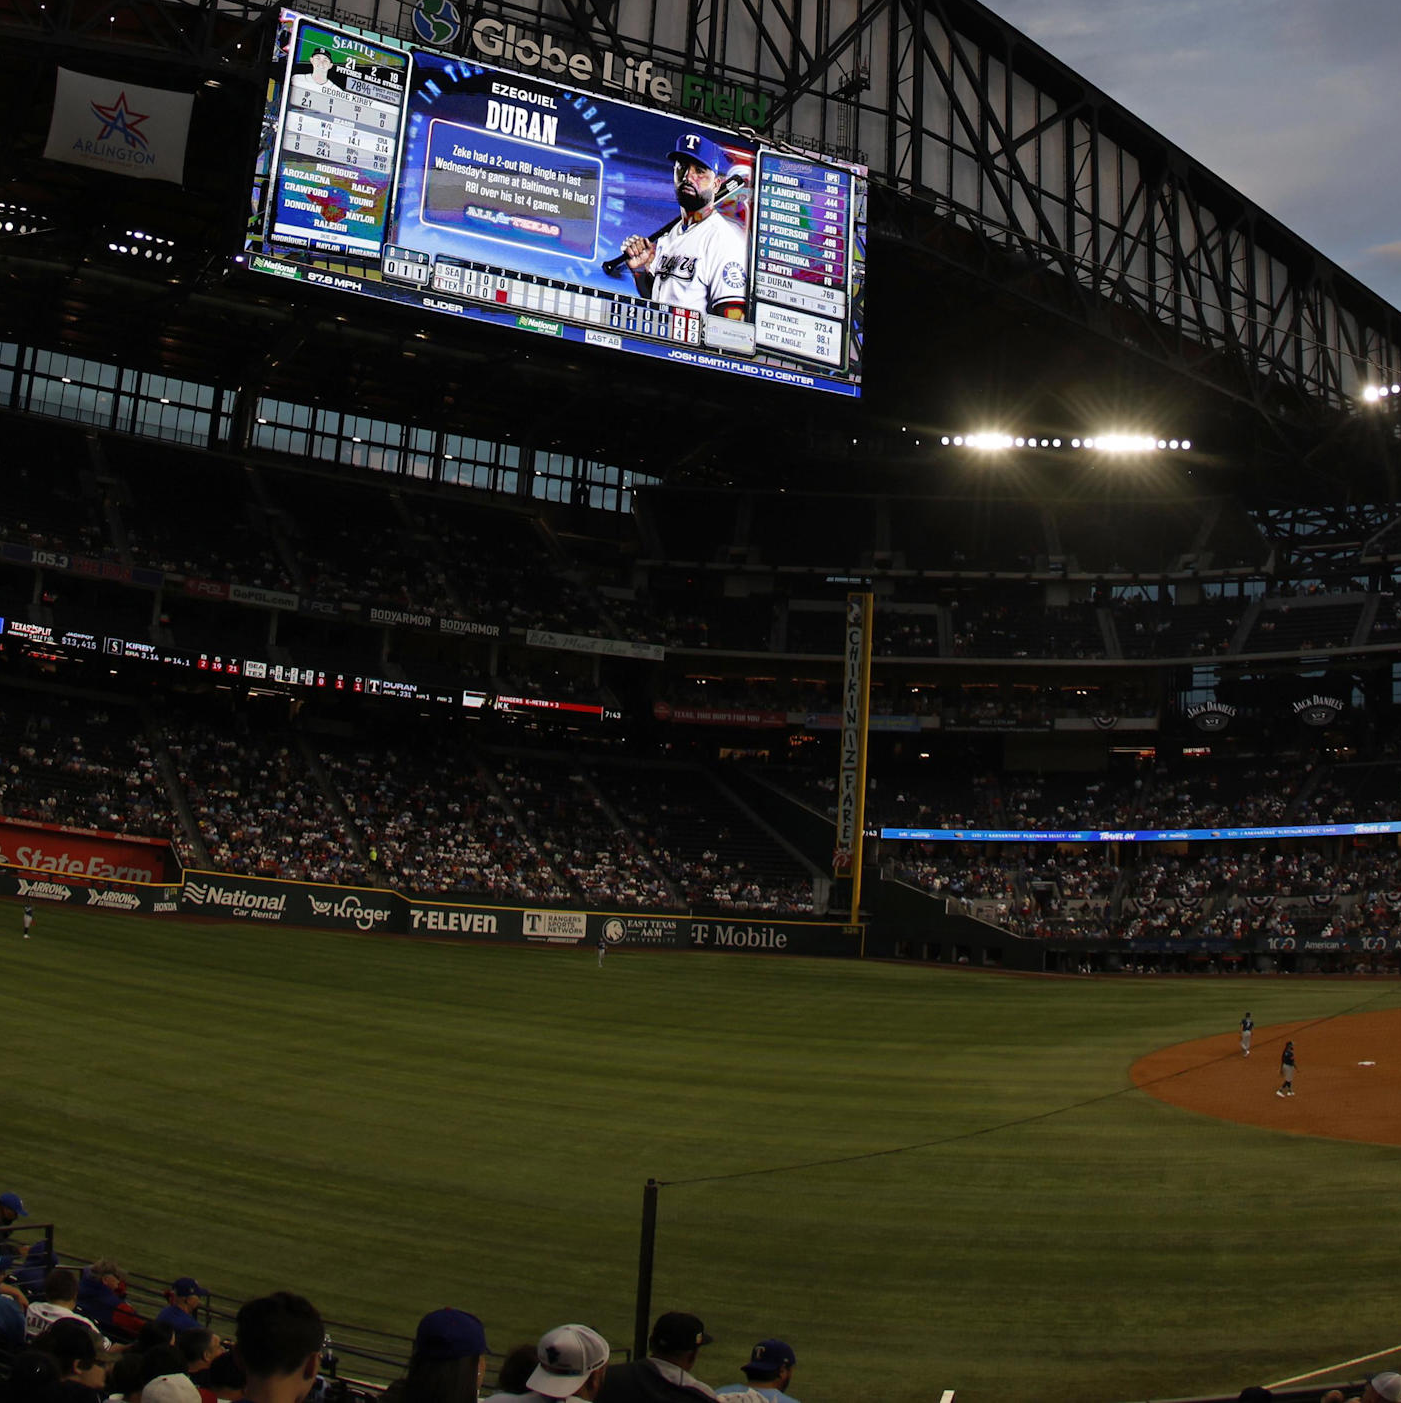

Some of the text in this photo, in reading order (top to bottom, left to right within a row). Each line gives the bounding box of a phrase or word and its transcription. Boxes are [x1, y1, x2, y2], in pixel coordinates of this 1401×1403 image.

[345, 57, 399, 83] 21 2 19
[472, 18, 767, 128] Globe Life Field
[351, 79, 371, 95] 78%
[301, 97, 312, 108] 2.1
[322, 86, 373, 107] GEORGE KIRBY
[491, 82, 558, 109] EZEQUIEL
[485, 99, 558, 146] DURAN
[321, 129, 388, 154] 1-1 14.1 3.14
[73, 138, 156, 165] ARLINGTON
[316, 148, 357, 165] 24.1 9.3
[453, 145, 581, 186] Zeke had a 2-out RBI single in last
[283, 168, 331, 185] AROZARENA
[435, 156, 596, 206] Wednesday's game at Baltimore. He had 3
[772, 175, 799, 186] NIMMO
[284, 181, 329, 198] CRAWFORD
[351, 183, 377, 195] RALEY
[771, 185, 811, 202] LANGFORD
[349, 196, 374, 208] YOUNG
[465, 181, 479, 194] RBI
[480, 187, 499, 199] over
[500, 189, 512, 202] his
[526, 195, 532, 206] 4
[533, 199, 561, 214] games.
[771, 199, 800, 212] SEAGER
[284, 199, 322, 214] DONOVAN
[314, 219, 348, 232] RALEIGH
[345, 211, 375, 225] NAYLOR
[770, 211, 800, 225] BURGER
[770, 225, 809, 241] PEDERSON
[316, 242, 341, 252] NAYLOR
[769, 236, 799, 251] CARTER
[263, 259, 298, 273] National
[769, 250, 810, 267] HIGASHIOKA
[444, 268, 460, 279] SEA
[768, 263, 793, 277] SMITH
[307, 271, 334, 285] 87.8
[333, 279, 362, 292] MPH
[444, 280, 458, 292] TEX
[767, 275, 834, 299] DURAN .769
[766, 290, 778, 299] .231
[769, 311, 833, 334] DISTANCE 373.4
[761, 320, 830, 345] EXIT VELOCITY 98.1
[422, 297, 815, 386] SLIDER National LAST AB JOSH SMITH FLIED TO CENTER
[765, 332, 780, 342] EXIT
[780, 337, 802, 348] ANGLE
[816, 346, 830, 356] 28.1
[31, 550, 69, 569] 105.3
[370, 608, 432, 627] BODYARMOR
[440, 618, 500, 637] BODYARMOR
[125, 641, 155, 652] KIRBY
[141, 652, 159, 661] 3.14
[383, 681, 418, 692] DURAN
[1186, 703, 1206, 719] JACK
[1292, 699, 1312, 714] JACK
[31, 881, 64, 897] ARROW
[100, 890, 133, 905] ARROW
[206, 886, 287, 912] National
[153, 902, 177, 912] HONDA
[232, 908, 282, 920] Car Rental
[333, 896, 391, 931] Kroger
[548, 915, 582, 923] RANGERS
[548, 922, 577, 930] SPORTS
[627, 919, 677, 931] EAST TEXAS
[548, 927, 584, 936] NETWORK
[640, 929, 662, 938] A&M
[714, 926, 788, 949] Mobile
[1304, 940, 1340, 951] American
